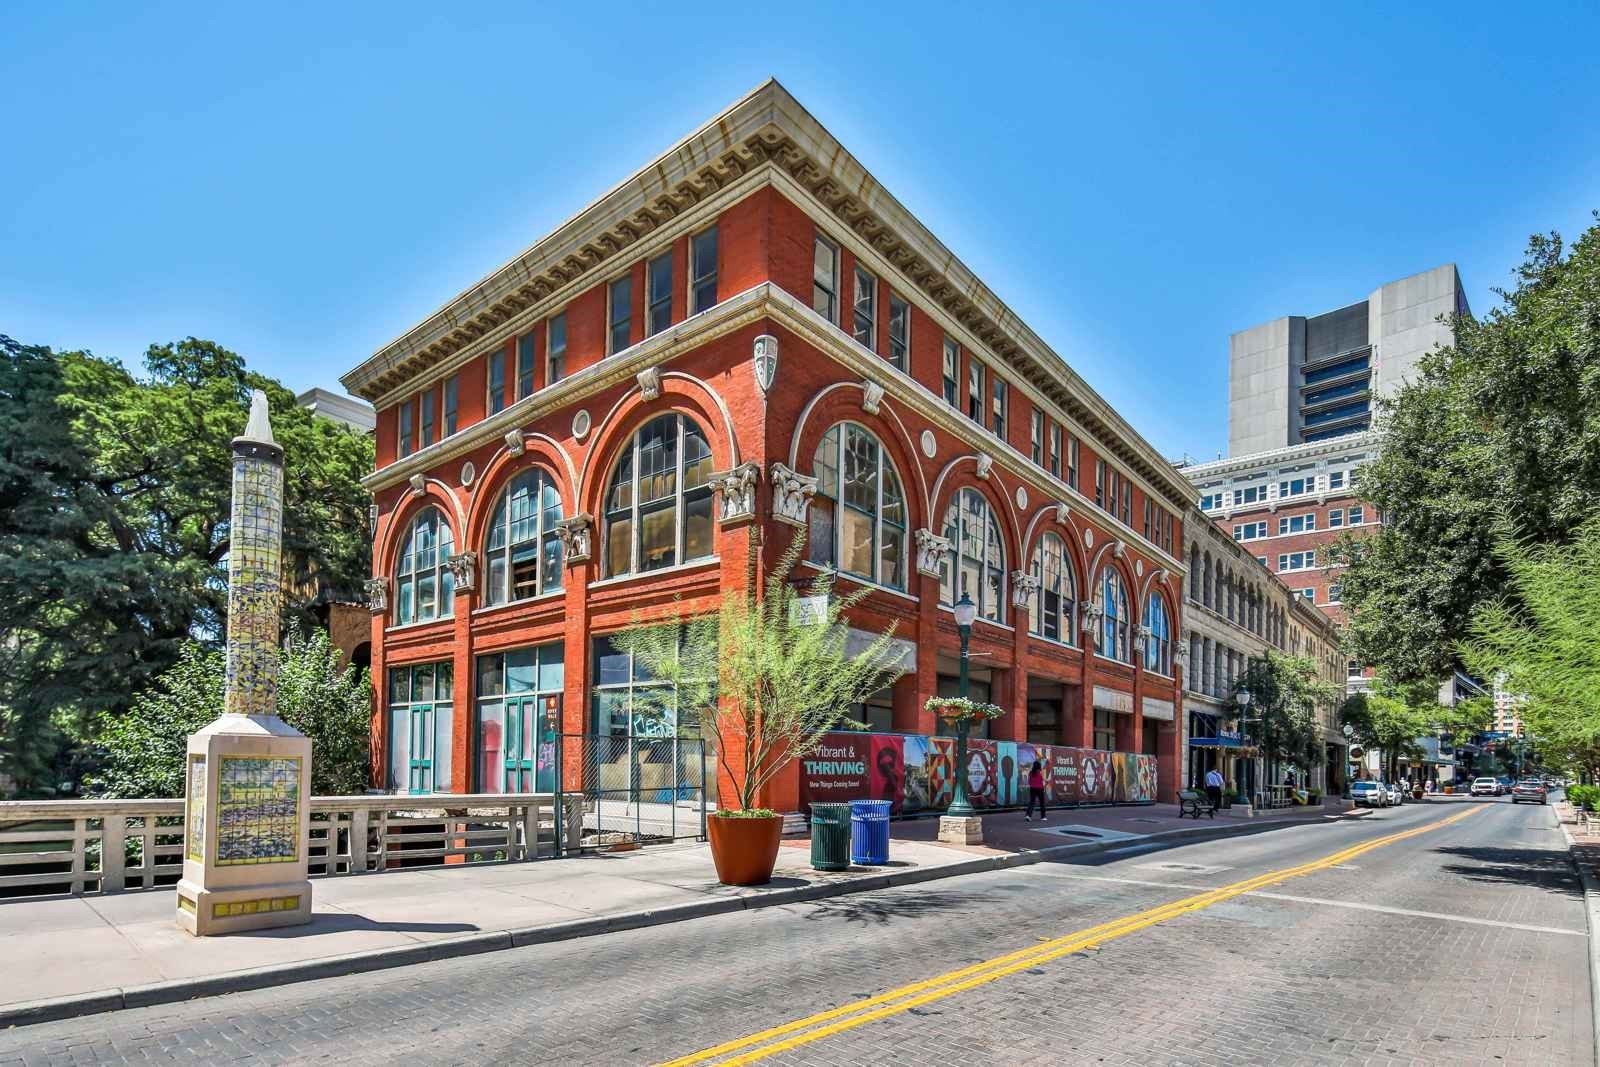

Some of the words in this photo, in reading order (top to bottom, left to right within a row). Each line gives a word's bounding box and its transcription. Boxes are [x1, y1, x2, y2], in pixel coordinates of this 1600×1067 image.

[813, 744, 846, 758] Vibrant
[848, 745, 855, 758] &
[804, 761, 865, 775] THRIVING
[1053, 766, 1078, 776] THRIVING
